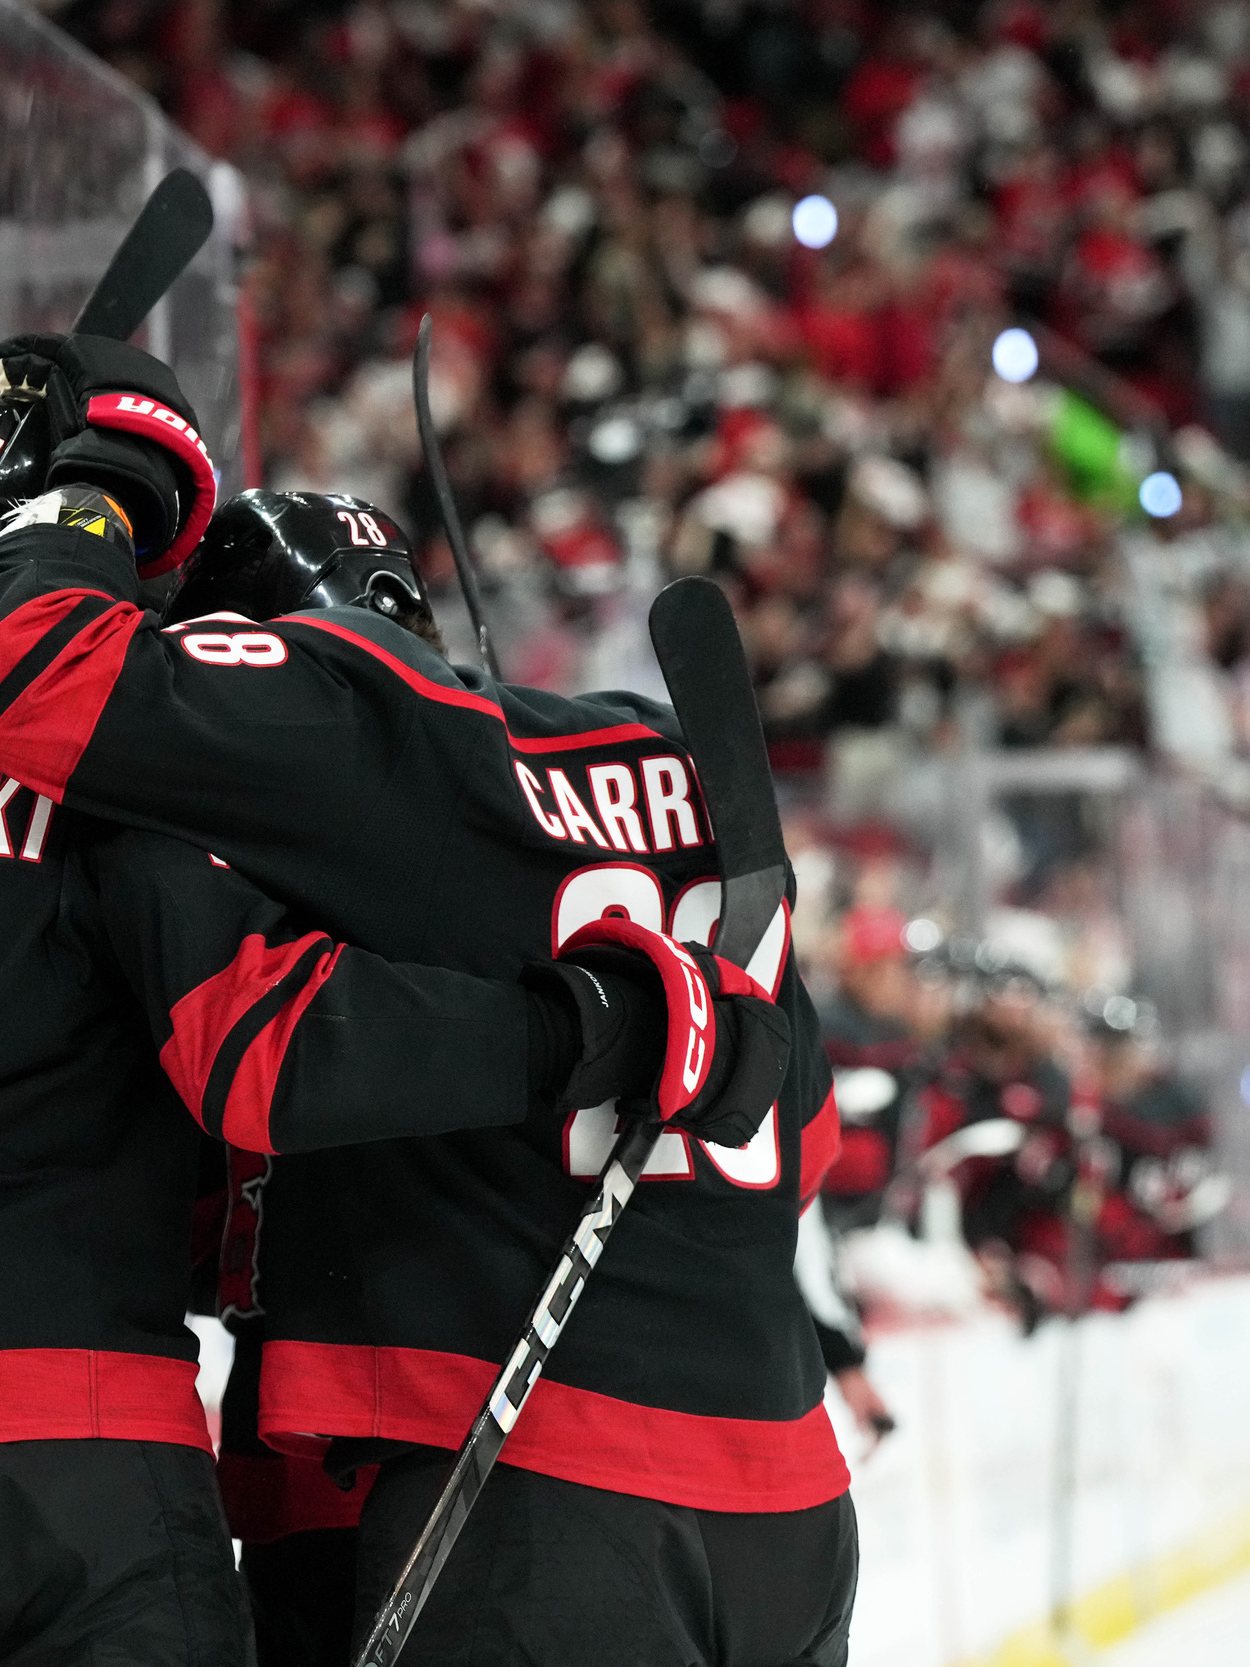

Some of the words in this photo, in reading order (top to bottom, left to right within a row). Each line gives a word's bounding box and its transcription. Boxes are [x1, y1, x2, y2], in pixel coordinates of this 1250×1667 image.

[336, 511, 388, 547] 28
[514, 753, 716, 854] CARR
[489, 1159, 634, 1433] CCM
[397, 1592, 412, 1618] PRO
